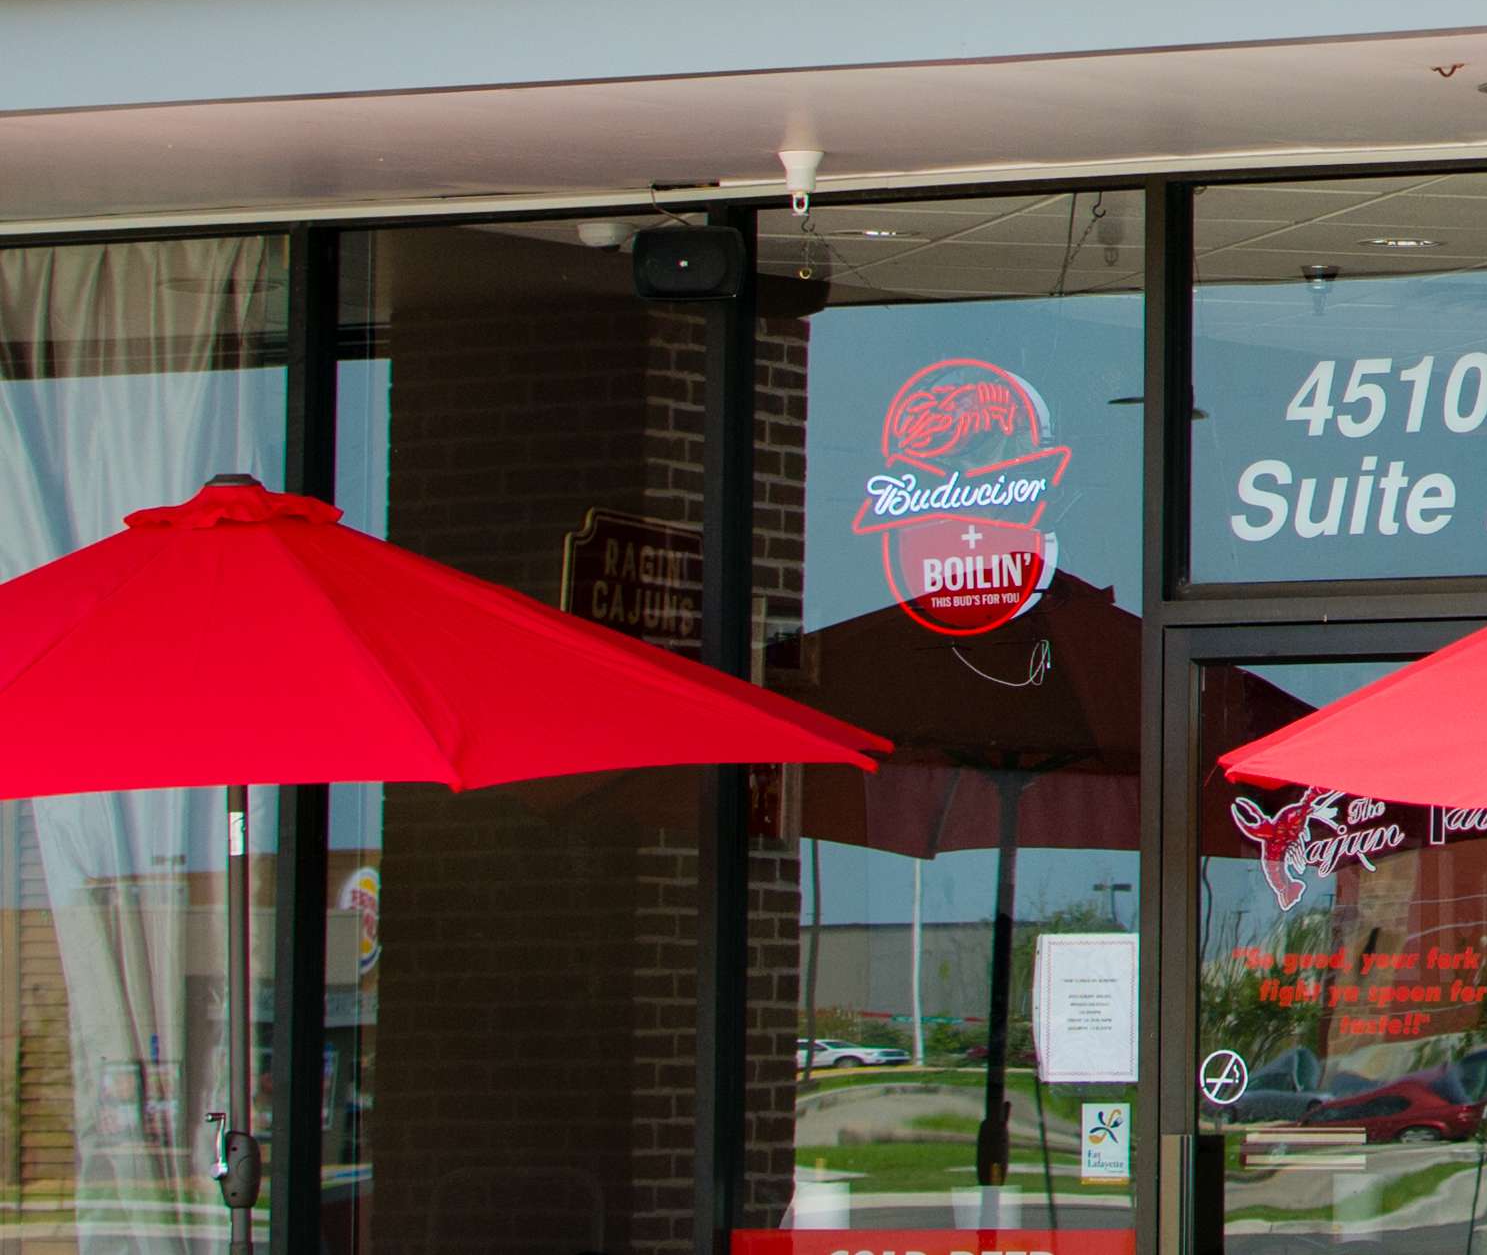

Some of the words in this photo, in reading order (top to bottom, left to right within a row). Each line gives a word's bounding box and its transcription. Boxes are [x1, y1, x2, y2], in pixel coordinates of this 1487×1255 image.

[866, 471, 1047, 515] Budweiser
[1231, 456, 1455, 541] Suite
[923, 552, 1032, 593] BOILIN'
[931, 597, 951, 608] THIS
[953, 595, 981, 607] BUD'S
[982, 595, 1000, 606] FOR
[1001, 592, 1020, 604] YOU
[1347, 797, 1386, 825] The
[1283, 949, 1354, 975] good,
[1359, 953, 1421, 976] your
[1426, 948, 1482, 971] fork
[1259, 979, 1322, 1008] fight
[1367, 985, 1442, 1009] spoon
[1450, 979, 1487, 1003] for
